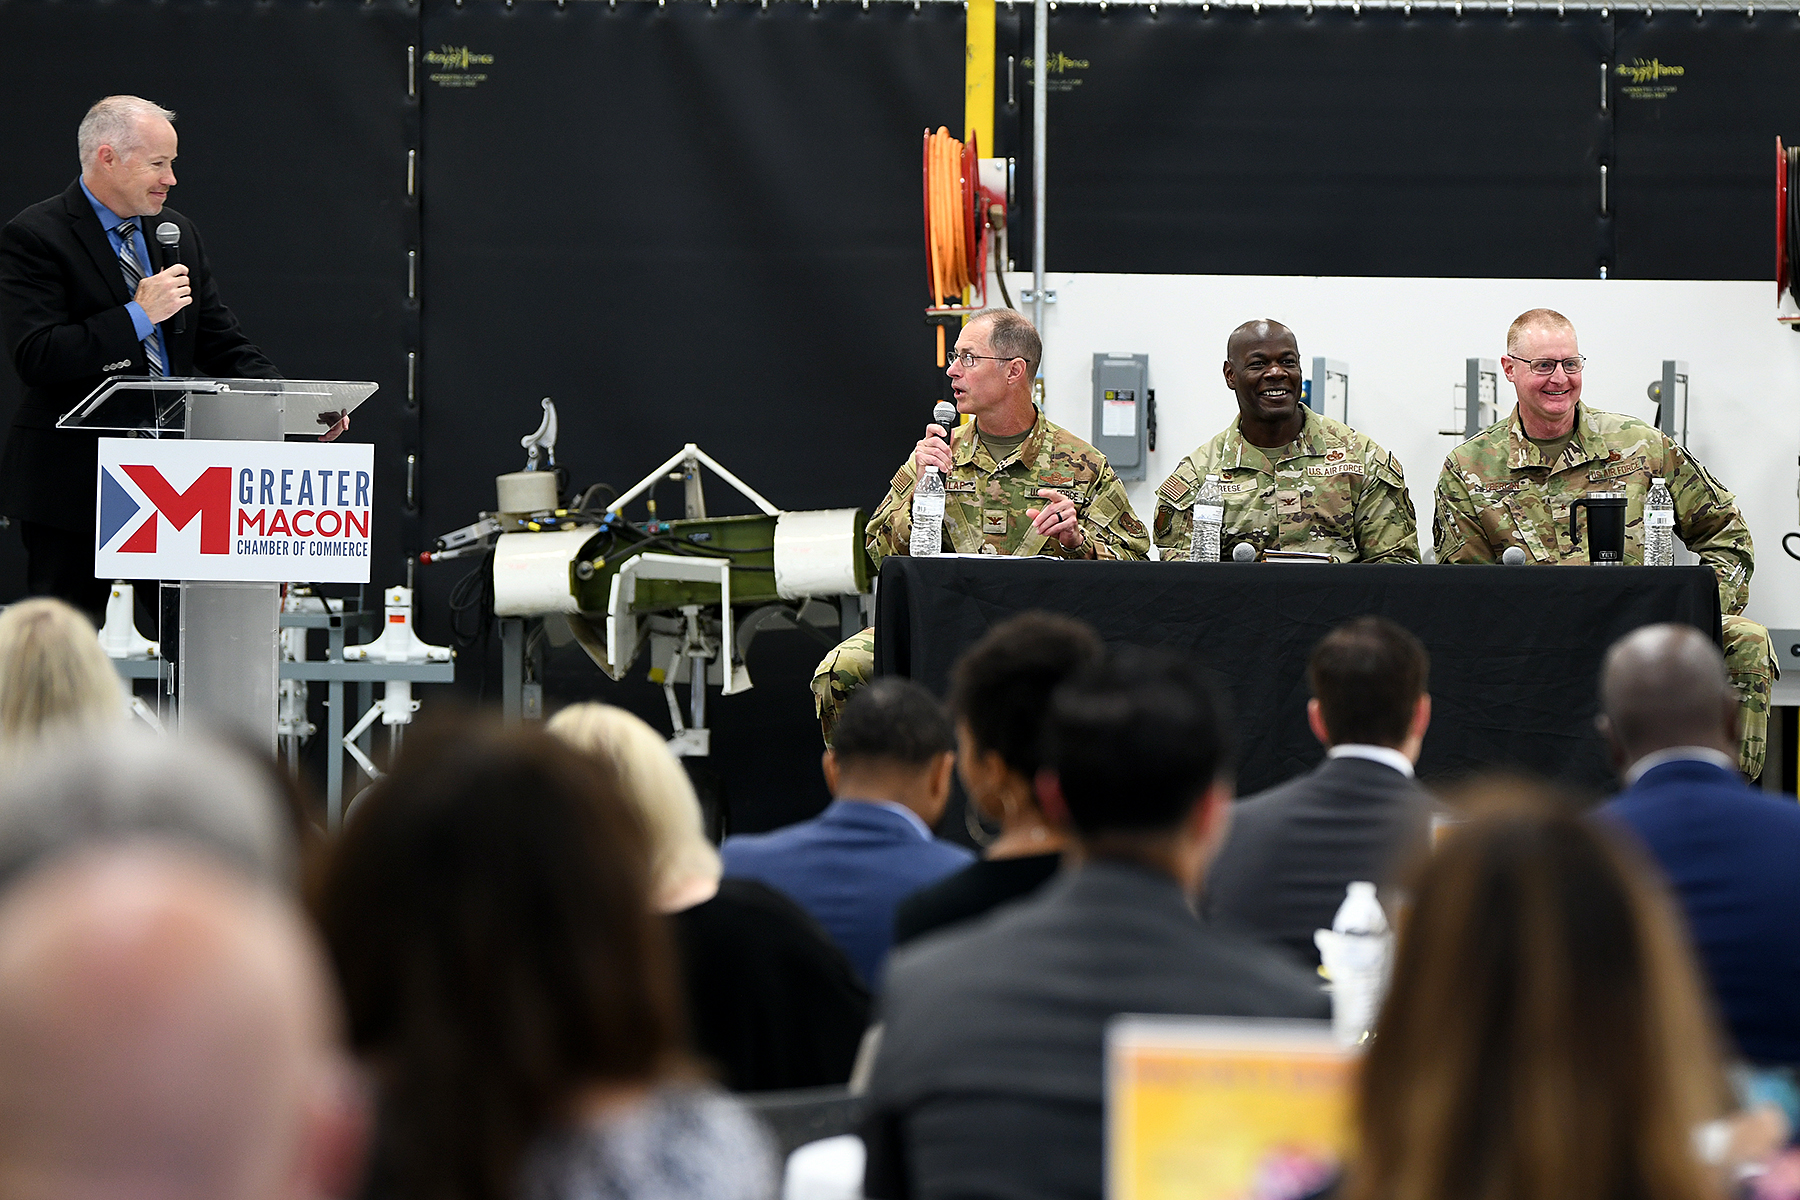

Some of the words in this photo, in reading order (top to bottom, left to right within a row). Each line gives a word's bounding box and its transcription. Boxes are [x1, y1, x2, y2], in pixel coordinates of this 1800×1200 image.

[1324, 467, 1337, 475] AIR
[1339, 464, 1363, 473] FORCE
[1604, 468, 1616, 477] AIR
[1617, 462, 1639, 475] FORCE
[239, 468, 370, 507] GREATER
[237, 508, 369, 538] MACON
[237, 540, 288, 556] CHAMBER
[293, 541, 305, 556] OF
[309, 541, 368, 557] COMMERCE
